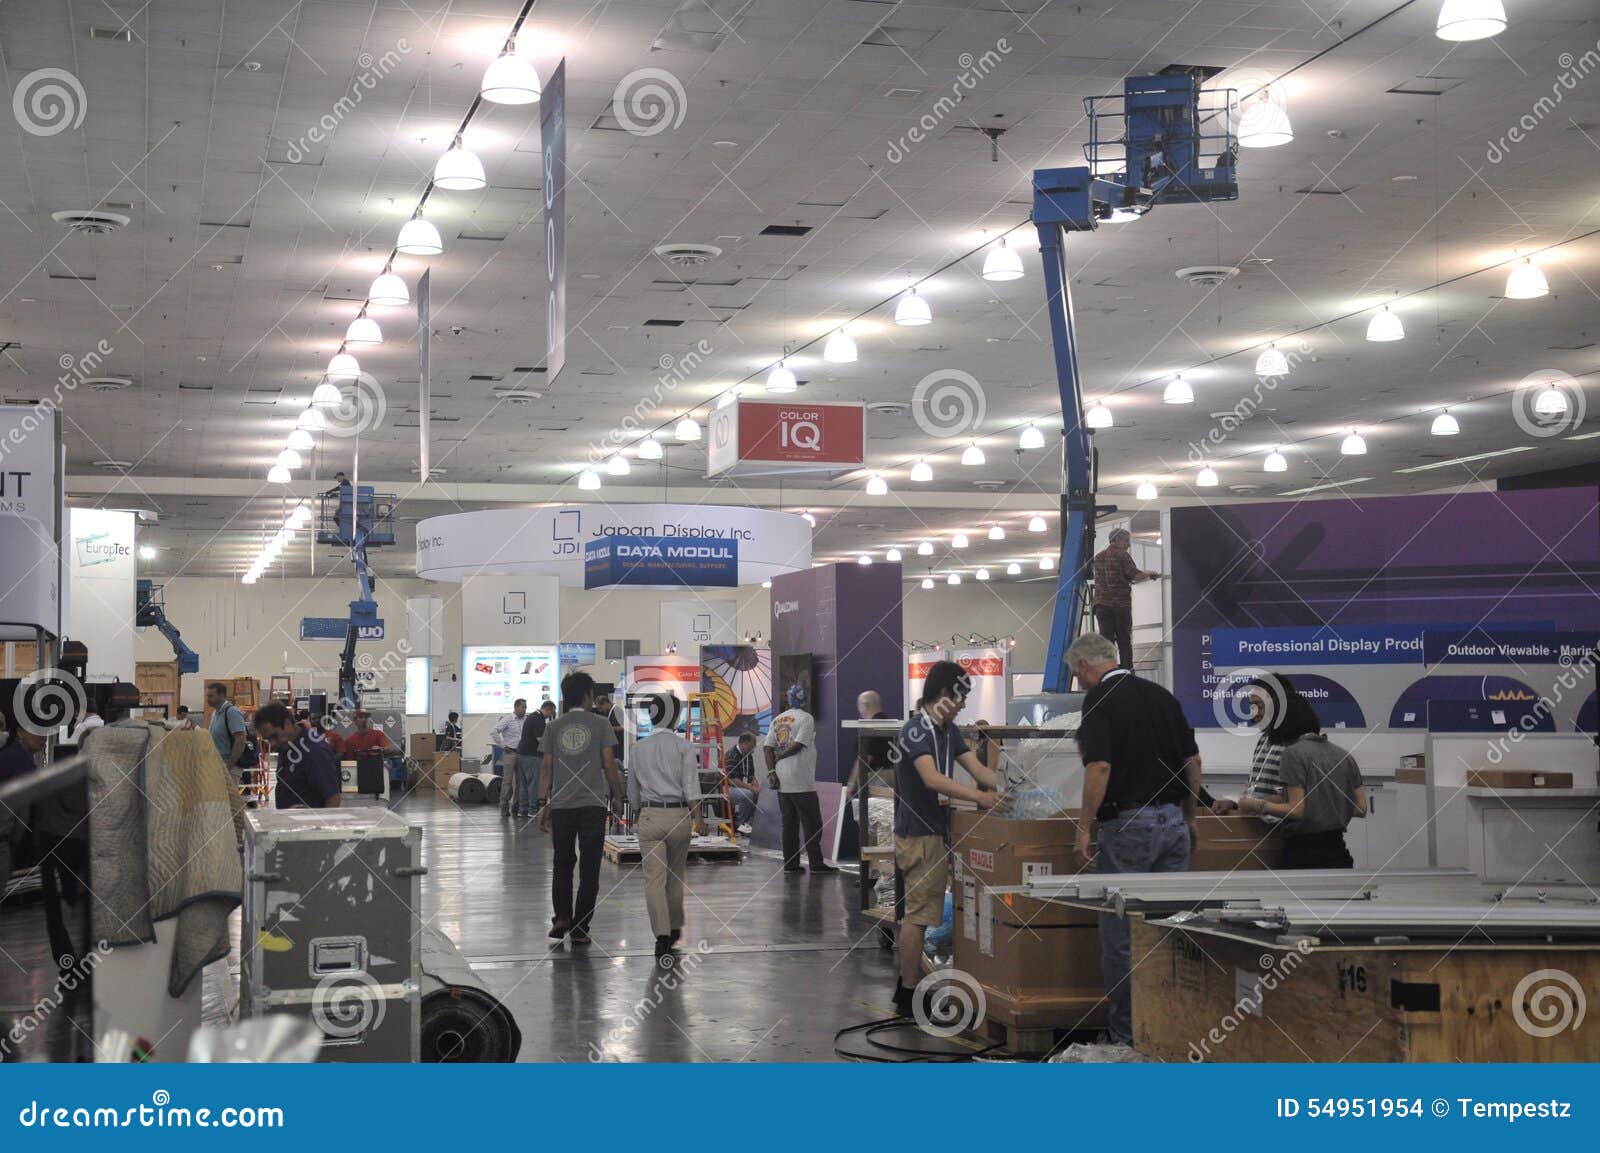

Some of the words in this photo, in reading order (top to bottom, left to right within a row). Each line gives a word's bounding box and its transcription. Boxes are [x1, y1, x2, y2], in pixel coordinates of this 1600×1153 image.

[780, 411, 819, 421] COLOR
[781, 421, 821, 452] IQ
[592, 524, 655, 537] Japan
[663, 524, 724, 538] Display
[730, 527, 756, 541] Inc.
[86, 540, 130, 556] EuropTec
[553, 542, 580, 555] JDI
[616, 546, 663, 557] DATA
[667, 546, 733, 559] MODUL
[503, 615, 527, 625] JDI
[693, 633, 712, 642] JDI
[1239, 639, 1324, 653] Professional
[1328, 639, 1381, 653] Display
[1447, 645, 1496, 656] Outdoor
[1500, 645, 1550, 656] Viewable
[1202, 675, 1250, 684] Ultra-Low
[1202, 689, 1234, 699] Digital
